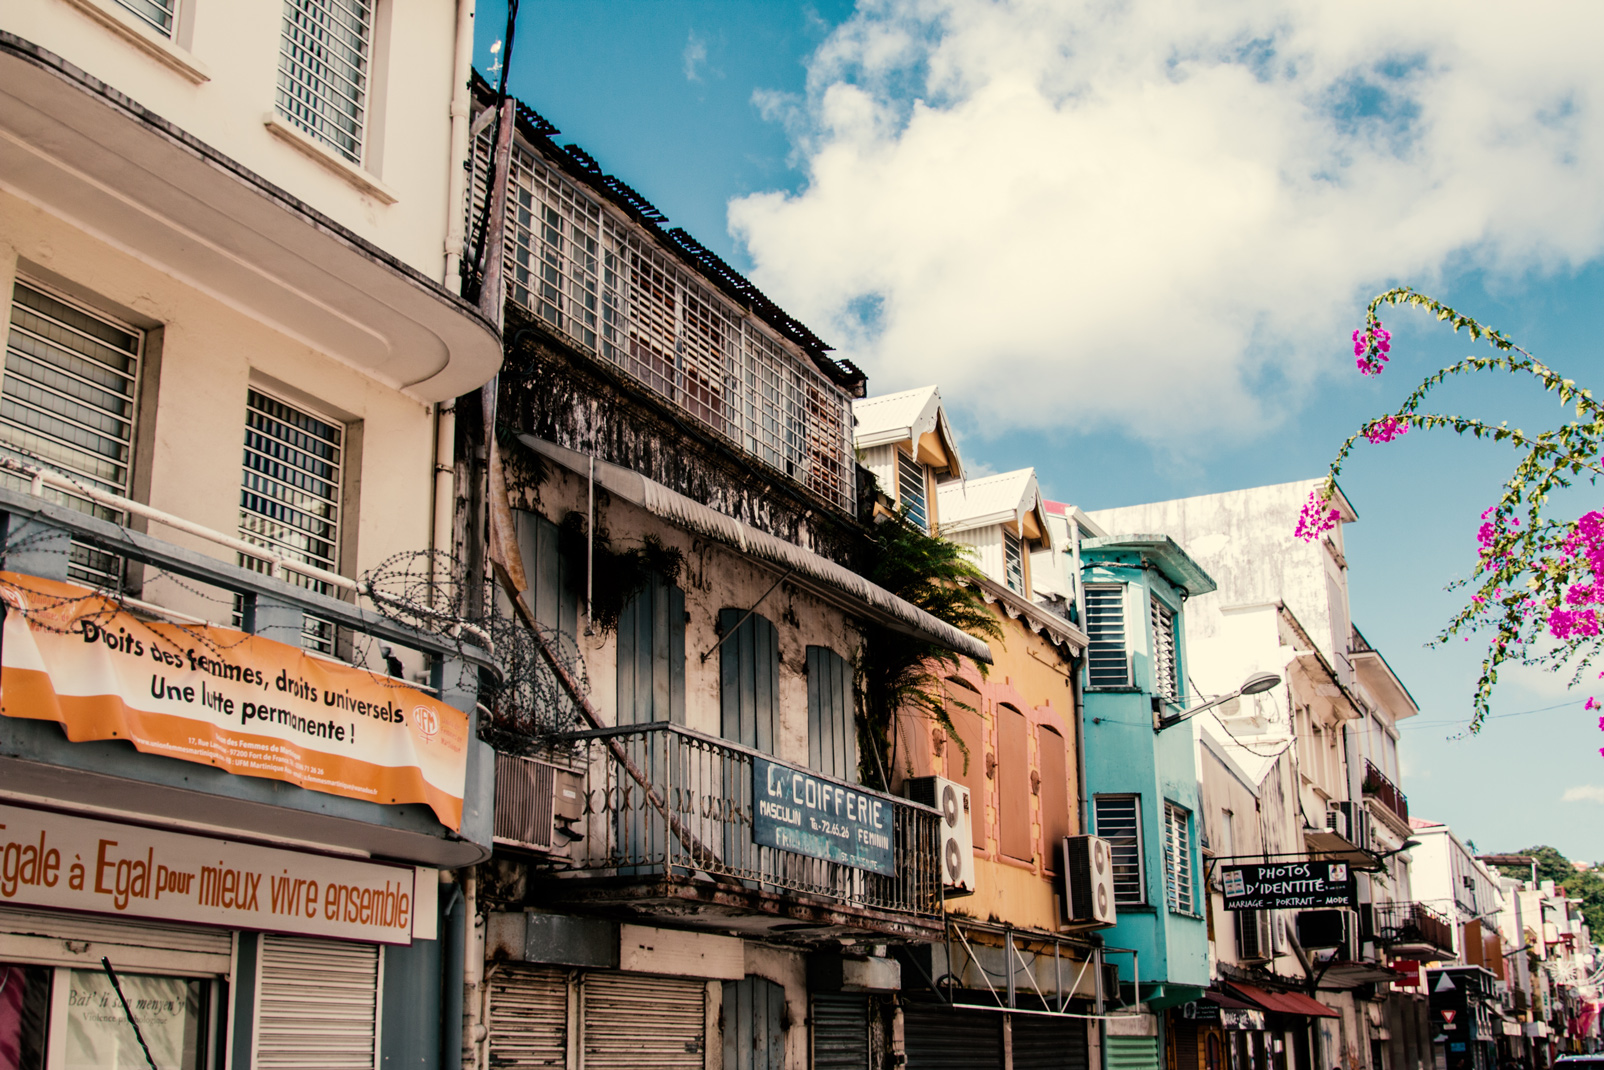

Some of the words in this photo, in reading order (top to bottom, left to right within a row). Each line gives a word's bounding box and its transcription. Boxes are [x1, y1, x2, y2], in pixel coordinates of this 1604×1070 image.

[80, 619, 144, 657] Droits
[150, 642, 184, 669] des
[187, 649, 269, 691] femmes,
[275, 669, 318, 703] droits
[151, 674, 195, 703] Une
[202, 680, 235, 716] lutte
[241, 701, 346, 742] permanente
[350, 723, 355, 744] !
[759, 799, 801, 826] MASCULIN
[857, 828, 889, 850] FEMININ
[792, 774, 883, 829] COIFFERIE
[68, 853, 85, 891] à
[94, 838, 154, 911] Egal
[199, 860, 262, 912] mieux
[271, 868, 319, 919] vivre
[324, 880, 410, 930] ensemble
[1258, 863, 1311, 880] PHOTOS
[1228, 899, 1264, 909] MARIAGE
[1275, 896, 1315, 907] PORTRAIT
[1325, 896, 1349, 905] MODE
